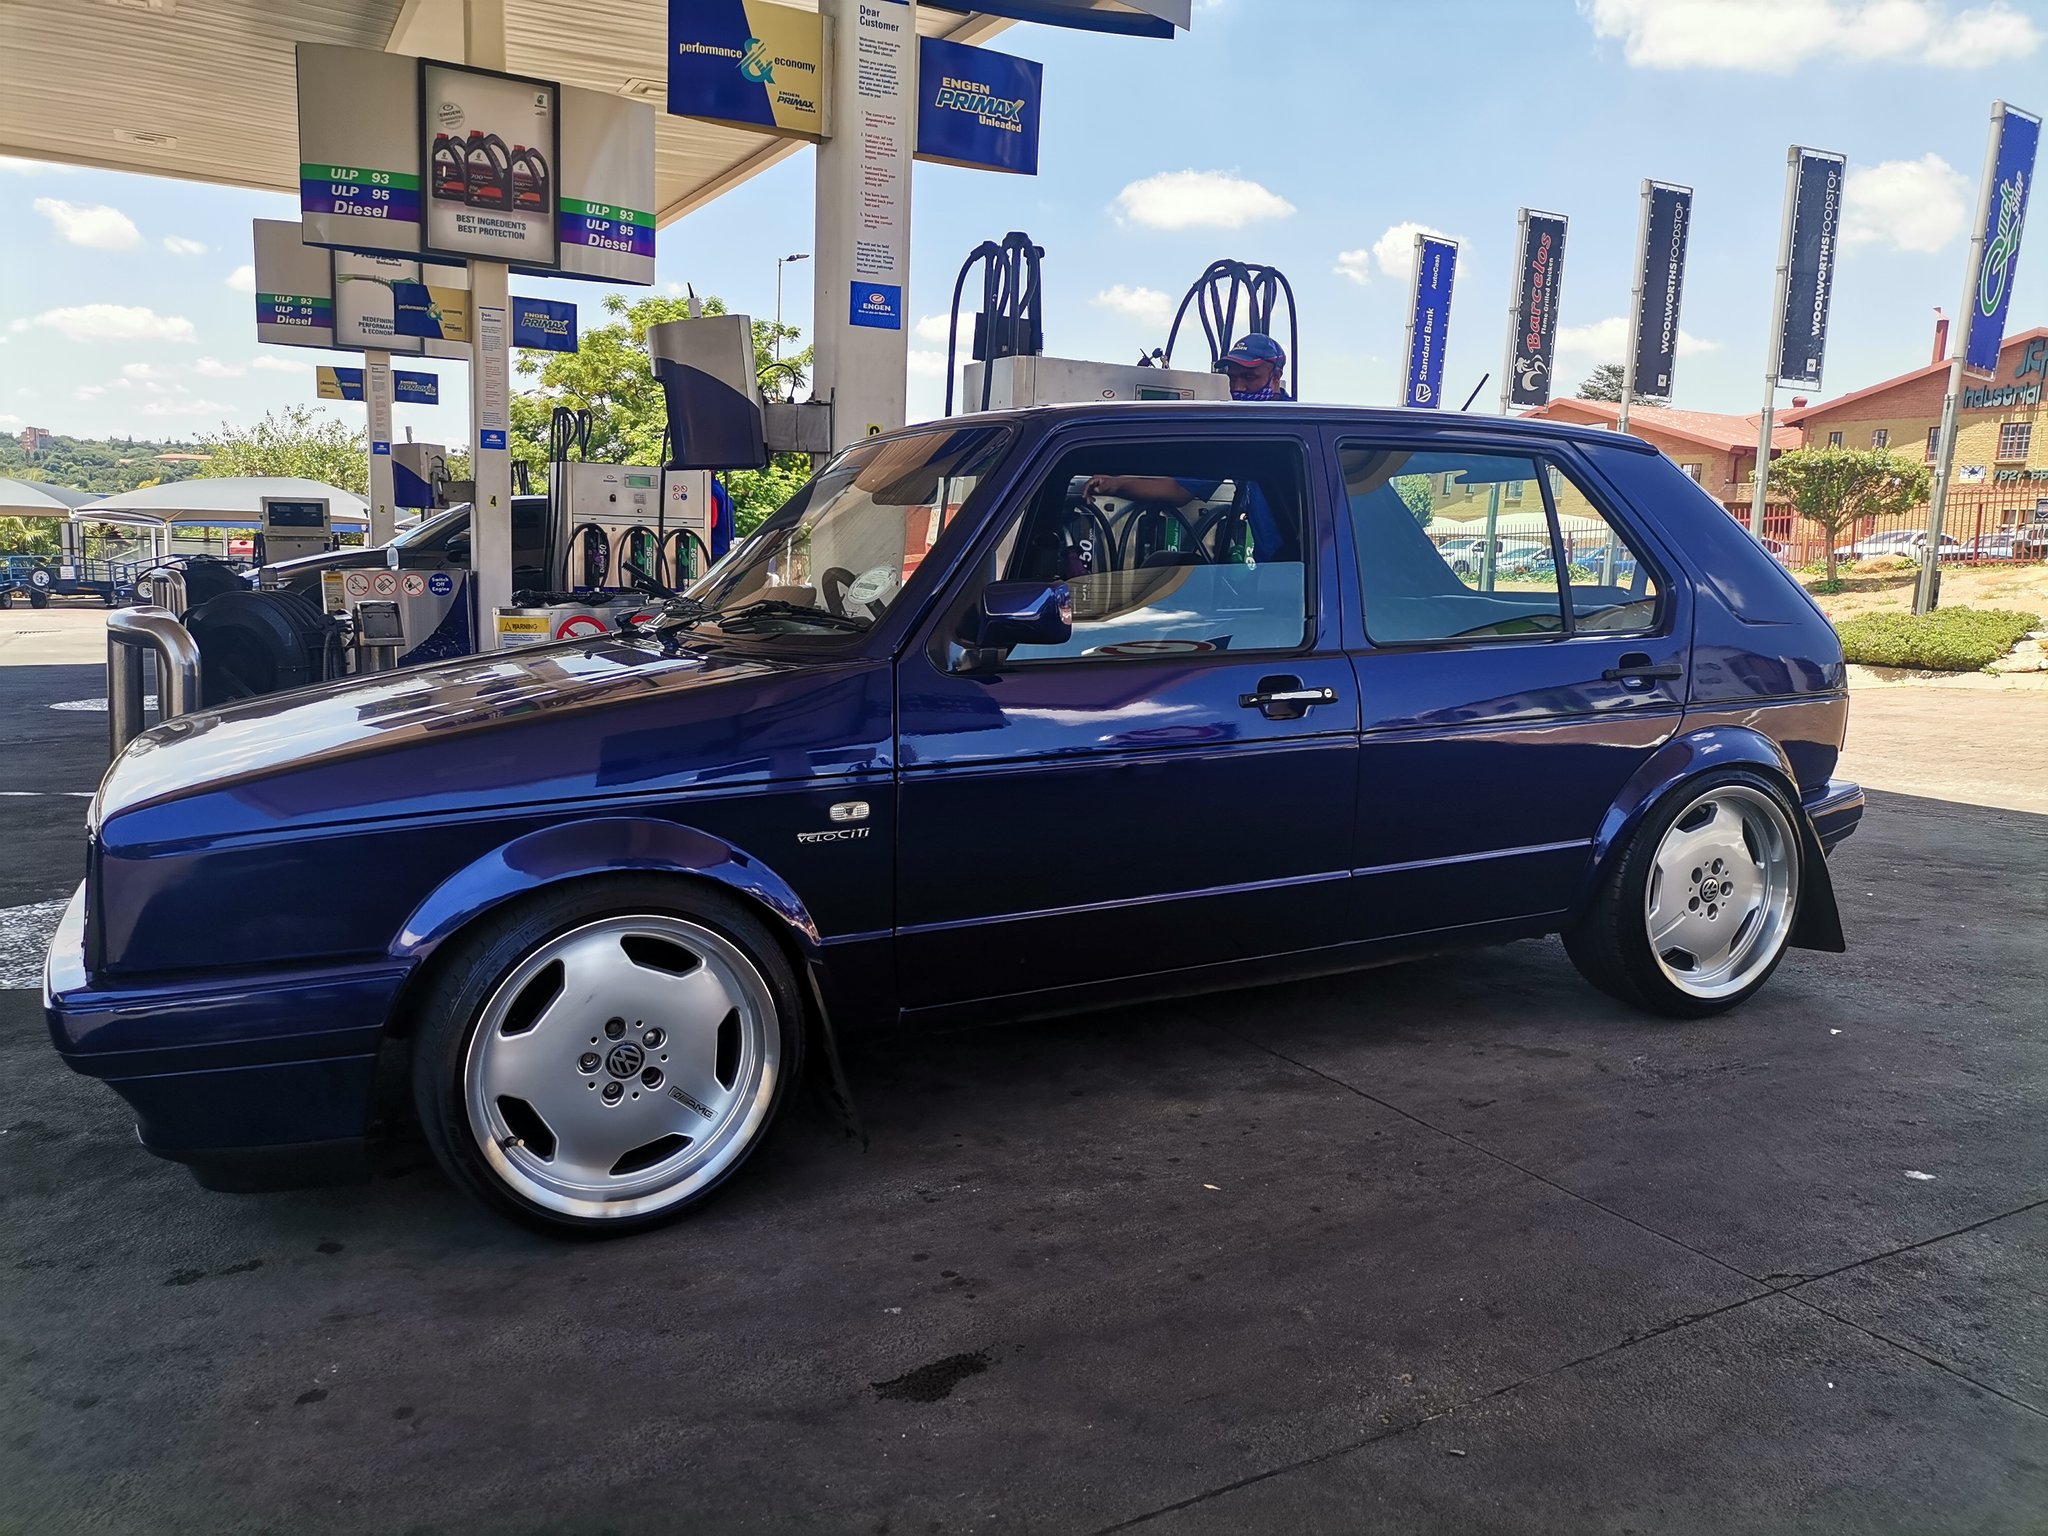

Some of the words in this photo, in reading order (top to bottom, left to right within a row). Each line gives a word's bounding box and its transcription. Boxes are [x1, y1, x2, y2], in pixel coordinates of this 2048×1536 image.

[860, 5, 880, 17] Dear
[860, 15, 899, 32] Customer
[680, 42, 742, 58] performance
[775, 57, 816, 74] economy
[943, 77, 990, 94] ENGEN
[777, 96, 814, 109] PRIMAX
[935, 88, 1025, 122] PRIMAX
[979, 115, 1021, 133] Unleaded
[330, 168, 359, 180] ULP
[371, 172, 390, 184] 93
[331, 184, 360, 197] ULP
[372, 189, 390, 200] 95
[2012, 171, 2023, 217] SHOP
[334, 200, 389, 218] Diesel
[586, 203, 610, 216] ULP
[619, 209, 634, 221] 93
[456, 214, 475, 224] BEST
[477, 217, 527, 231] INGREDIENTS
[586, 218, 610, 231] ULP
[619, 224, 634, 236] 95
[458, 224, 477, 234] BEST
[479, 227, 525, 240] PROTECTION
[588, 233, 633, 252] Diesel
[1431, 254, 1441, 290] AutoCash
[1546, 257, 1554, 286] Chicken
[274, 295, 293, 303] ULP
[300, 297, 313, 305] 93
[1527, 232, 1552, 353] Barcelos
[1543, 285, 1551, 313] Grilled
[275, 305, 293, 313] ULP
[300, 307, 313, 315] 95
[863, 303, 891, 311] ENGEN
[276, 314, 312, 325] Diesel
[362, 316, 394, 324] REDEFININ
[521, 317, 568, 331] PRIMAX
[1424, 307, 1435, 335] Bank
[1541, 313, 1549, 335] Flame
[1420, 336, 1432, 382] Standard
[490, 496, 497, 507] 4
[600, 544, 607, 555] 50
[646, 547, 653, 557] 95
[690, 548, 697, 558] 93
[1079, 539, 1093, 562] 50
